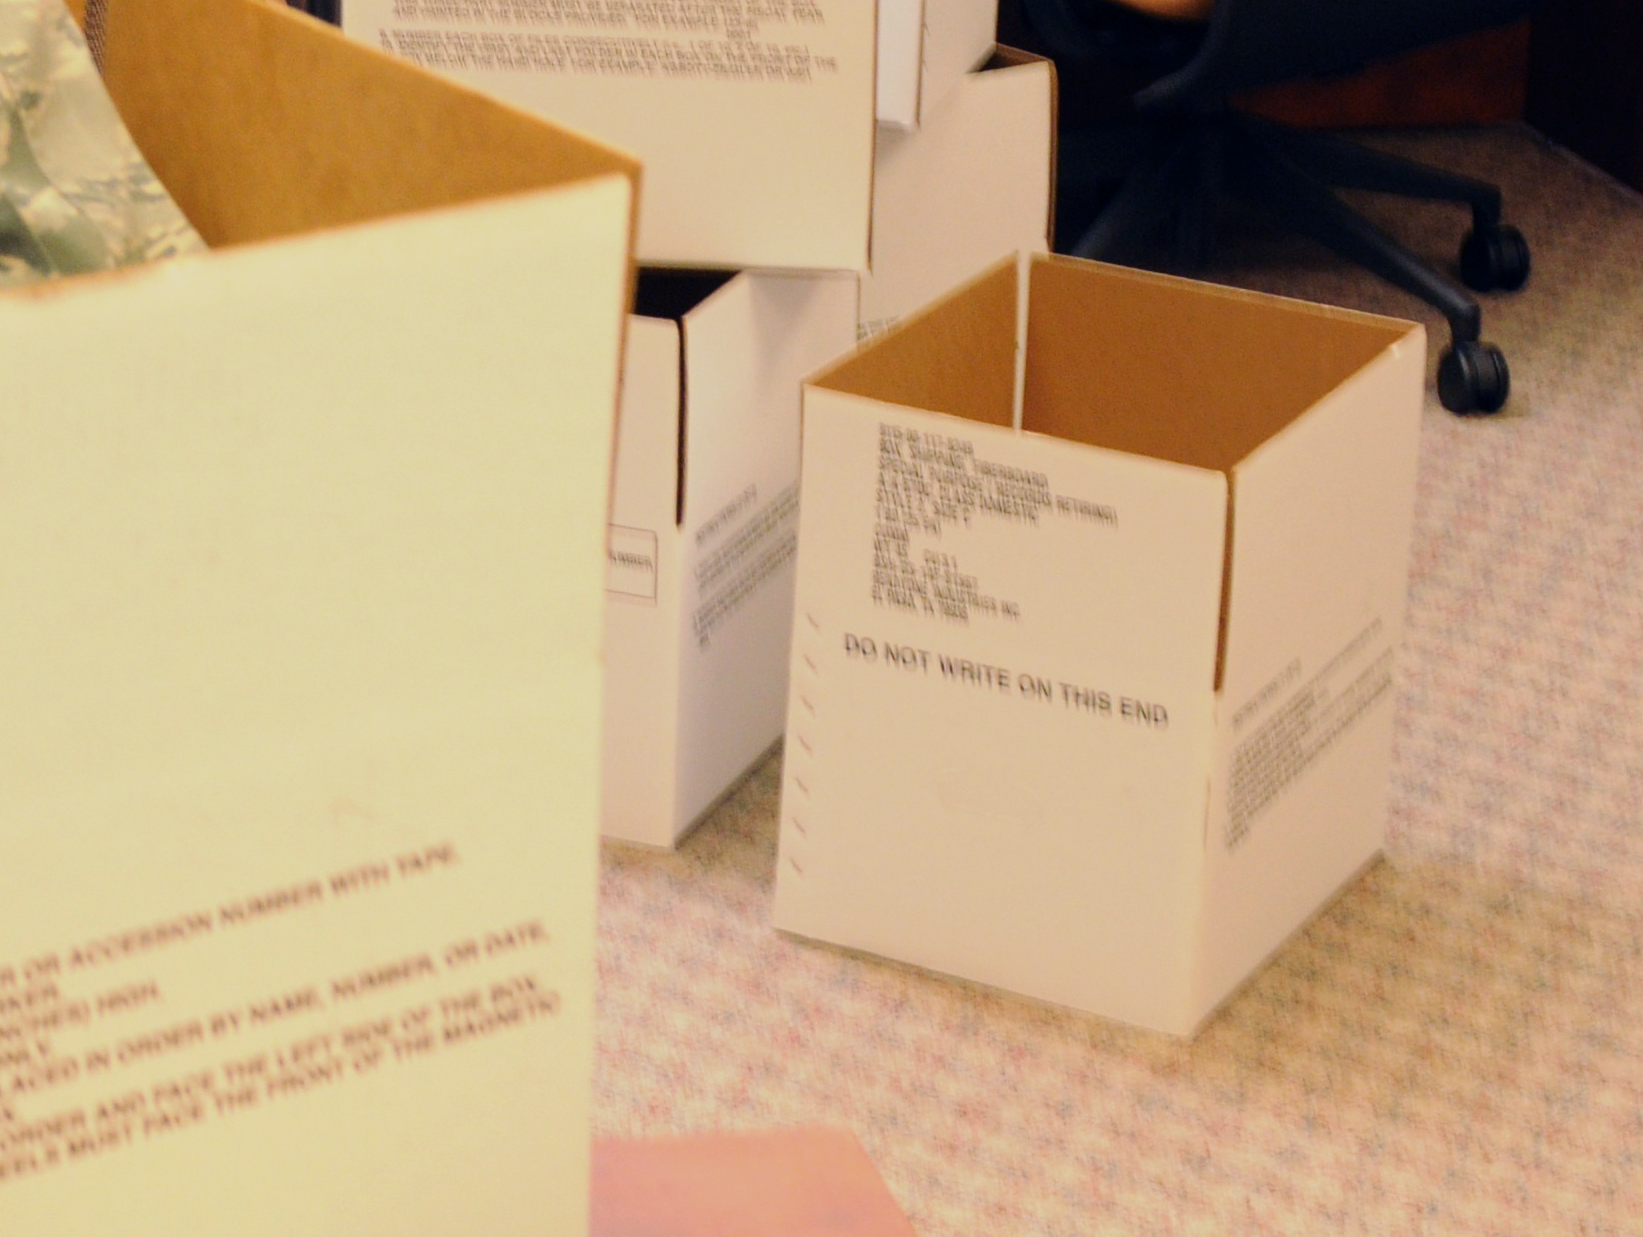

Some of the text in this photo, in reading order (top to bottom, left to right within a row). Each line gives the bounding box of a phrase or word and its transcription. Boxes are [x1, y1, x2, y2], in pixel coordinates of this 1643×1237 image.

[844, 632, 1169, 731] DO NOT WRITE ON THIS END
[26, 952, 61, 981] OR
[69, 910, 212, 969] ACCESSION
[220, 879, 323, 926] NUMBER
[330, 860, 389, 896] WITH
[87, 1044, 112, 1071] IN
[116, 1017, 203, 1062] ORDER
[211, 1006, 240, 1034] BY
[445, 936, 478, 966] OR
[0, 1108, 84, 1151] ORDER
[97, 1090, 144, 1122] AND
[153, 1069, 213, 1105] FACE
[223, 1053, 266, 1085] THE
[277, 1034, 330, 1068] LEFT
[341, 1016, 391, 1049] SIDE
[402, 1005, 429, 1031] OF
[439, 990, 479, 1020] THE
[67, 1121, 133, 1158] MUST
[144, 1099, 203, 1135] FACE
[215, 1083, 256, 1113] THE
[267, 1057, 344, 1098] FRONT
[352, 1046, 380, 1072] OF
[393, 1031, 431, 1060] THE
